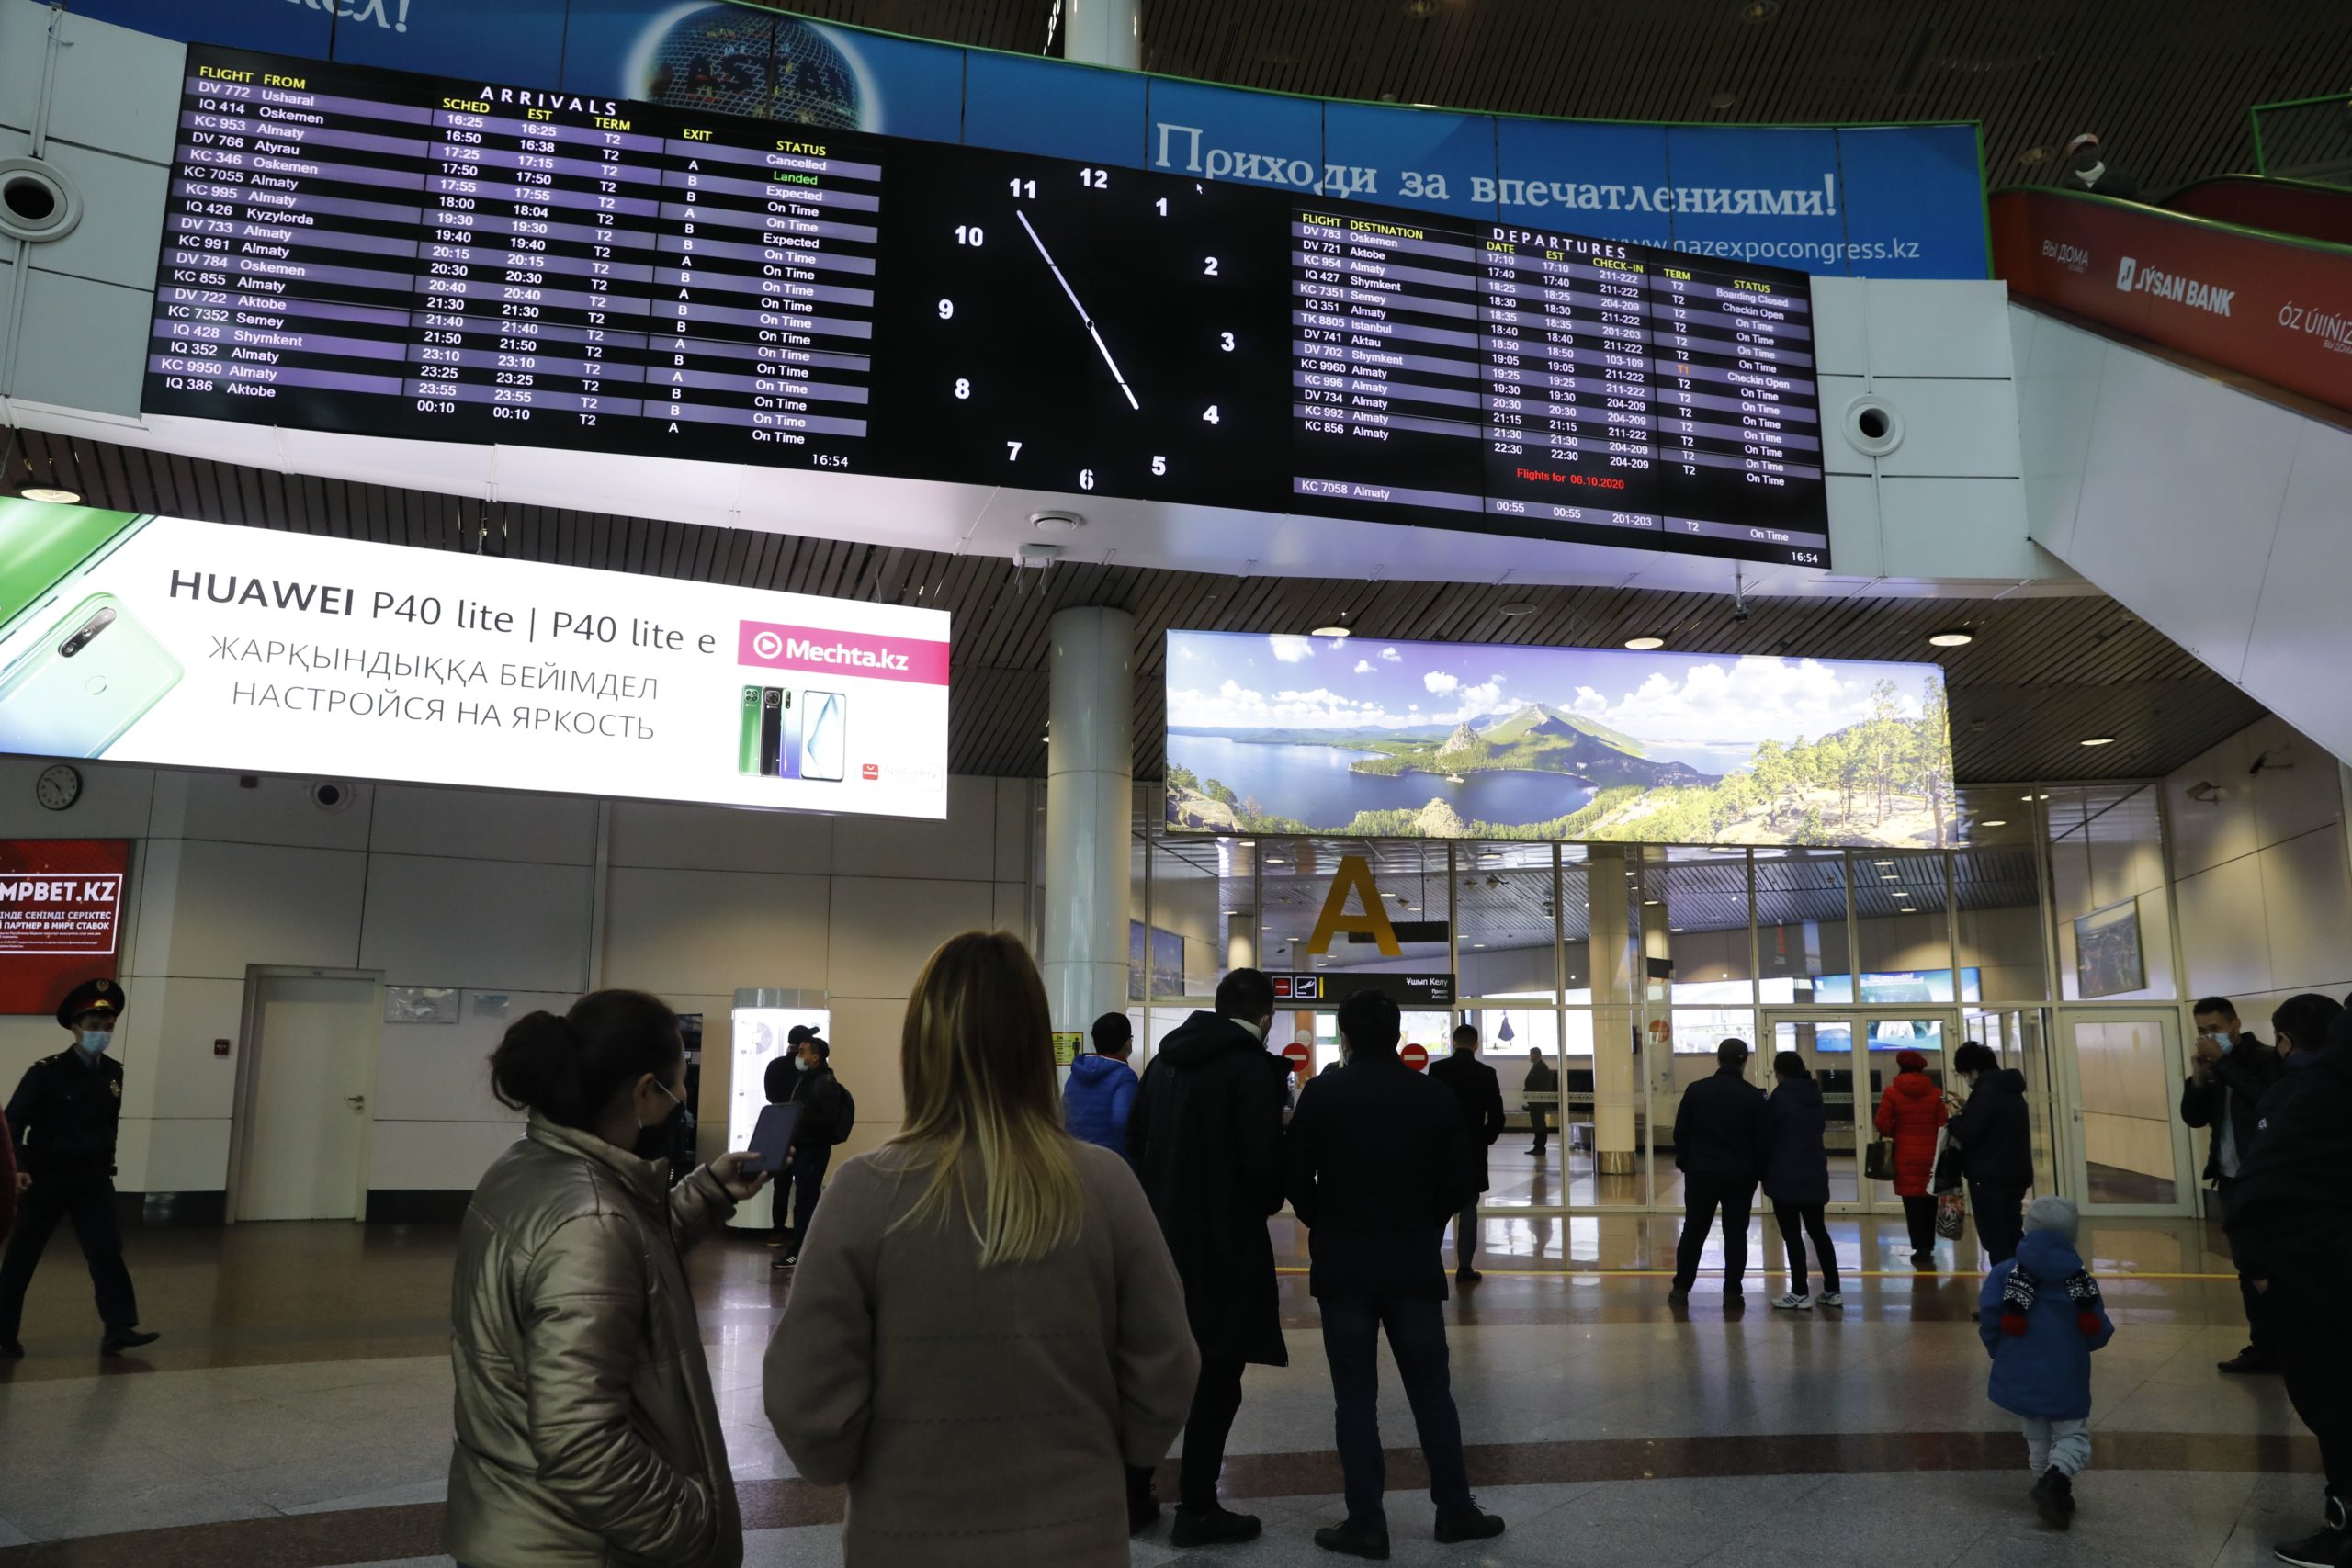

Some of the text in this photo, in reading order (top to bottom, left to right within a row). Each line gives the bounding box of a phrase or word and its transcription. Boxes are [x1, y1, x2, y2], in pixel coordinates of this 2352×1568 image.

[199, 65, 826, 156] FLIGHT FROM SCHED EST TERM EXIT STATUS
[481, 85, 617, 116] ARRIVALS
[199, 98, 818, 186] IQ 414 Oskemen 16:50 16:38 T2 A Landed
[1080, 168, 1108, 188] 12
[1155, 122, 1837, 217] Приходи за впечатлениями!
[1010, 178, 1036, 198] 11
[184, 165, 820, 249] KC 7055 Almaty 18:00 18:04 T2 B Expected
[1156, 197, 1168, 216] 1
[186, 200, 815, 280] IQ 426 Kyzylorda 19:40 19:40 T2 A On Time
[955, 225, 984, 247] 10
[1493, 227, 1626, 258] DEPARTURES
[1600, 237, 1921, 264] wqazexpocongress.kz
[1204, 257, 1218, 276] 2
[1303, 213, 1342, 228] FLIGHT
[1350, 220, 1423, 240] DESTINATION
[1487, 241, 1515, 254] DATE
[1546, 250, 1565, 261] EST
[1664, 268, 1690, 280] TERM
[1734, 279, 1770, 294] STATUS
[1303, 225, 1789, 308] DV 783 Oskemen 17:10 17:10 211-222 T2 Boarding Closed
[2042, 240, 2088, 267] ВЫ ДОМА
[938, 299, 954, 319] 9
[1305, 269, 1775, 345] IQ 427 Shymkent 18:30 18:30 211-222 T2 On Time
[2186, 280, 2235, 317] BANK
[2278, 300, 2304, 330] ÓZ
[168, 305, 809, 378] KC 7352 Semey 21:50 21:50 T2 B On Time
[1220, 332, 1235, 352] 3
[1301, 312, 1791, 389] TK 8805 Istanbul 18:50 18:50 103-109 T1 Checkin Open
[955, 378, 970, 399] 8
[165, 377, 805, 445] IQ 386 Aktobe 00:10 00:10 T2 A On Time
[1203, 405, 1219, 424] 4
[813, 454, 849, 468] 16:54
[1007, 441, 1022, 461] 7
[1151, 456, 1166, 476] 5
[1305, 420, 1785, 486] KC 856 Almaty 22:30 22:30 204-209 T2 On Time
[1080, 468, 1094, 490] 6
[1517, 468, 1624, 489] Flights for 06.10.2020
[1302, 479, 1789, 542] KC 7058 Almaty 00:55 00:55 201-203 T2 On Time
[1792, 551, 1818, 563] 16:54
[169, 569, 717, 655] HUAWEI P40 lite P40 lite e
[786, 637, 910, 671] Mechta.kz
[208, 635, 659, 705] ЖАРҚЫНДЫҚҚА БЕЙІМДЕЛ
[232, 680, 655, 740] НАСТРОЙСЯ НА ЯРКОСТЬ
[67, 911, 112, 919] СЕРІКТЕС
[1306, 855, 1403, 956] A
[4, 921, 42, 930] ПАРТНЕР
[43, 921, 51, 930] В
[51, 921, 75, 930] МИРЕ
[76, 921, 110, 930] СТАВОК
